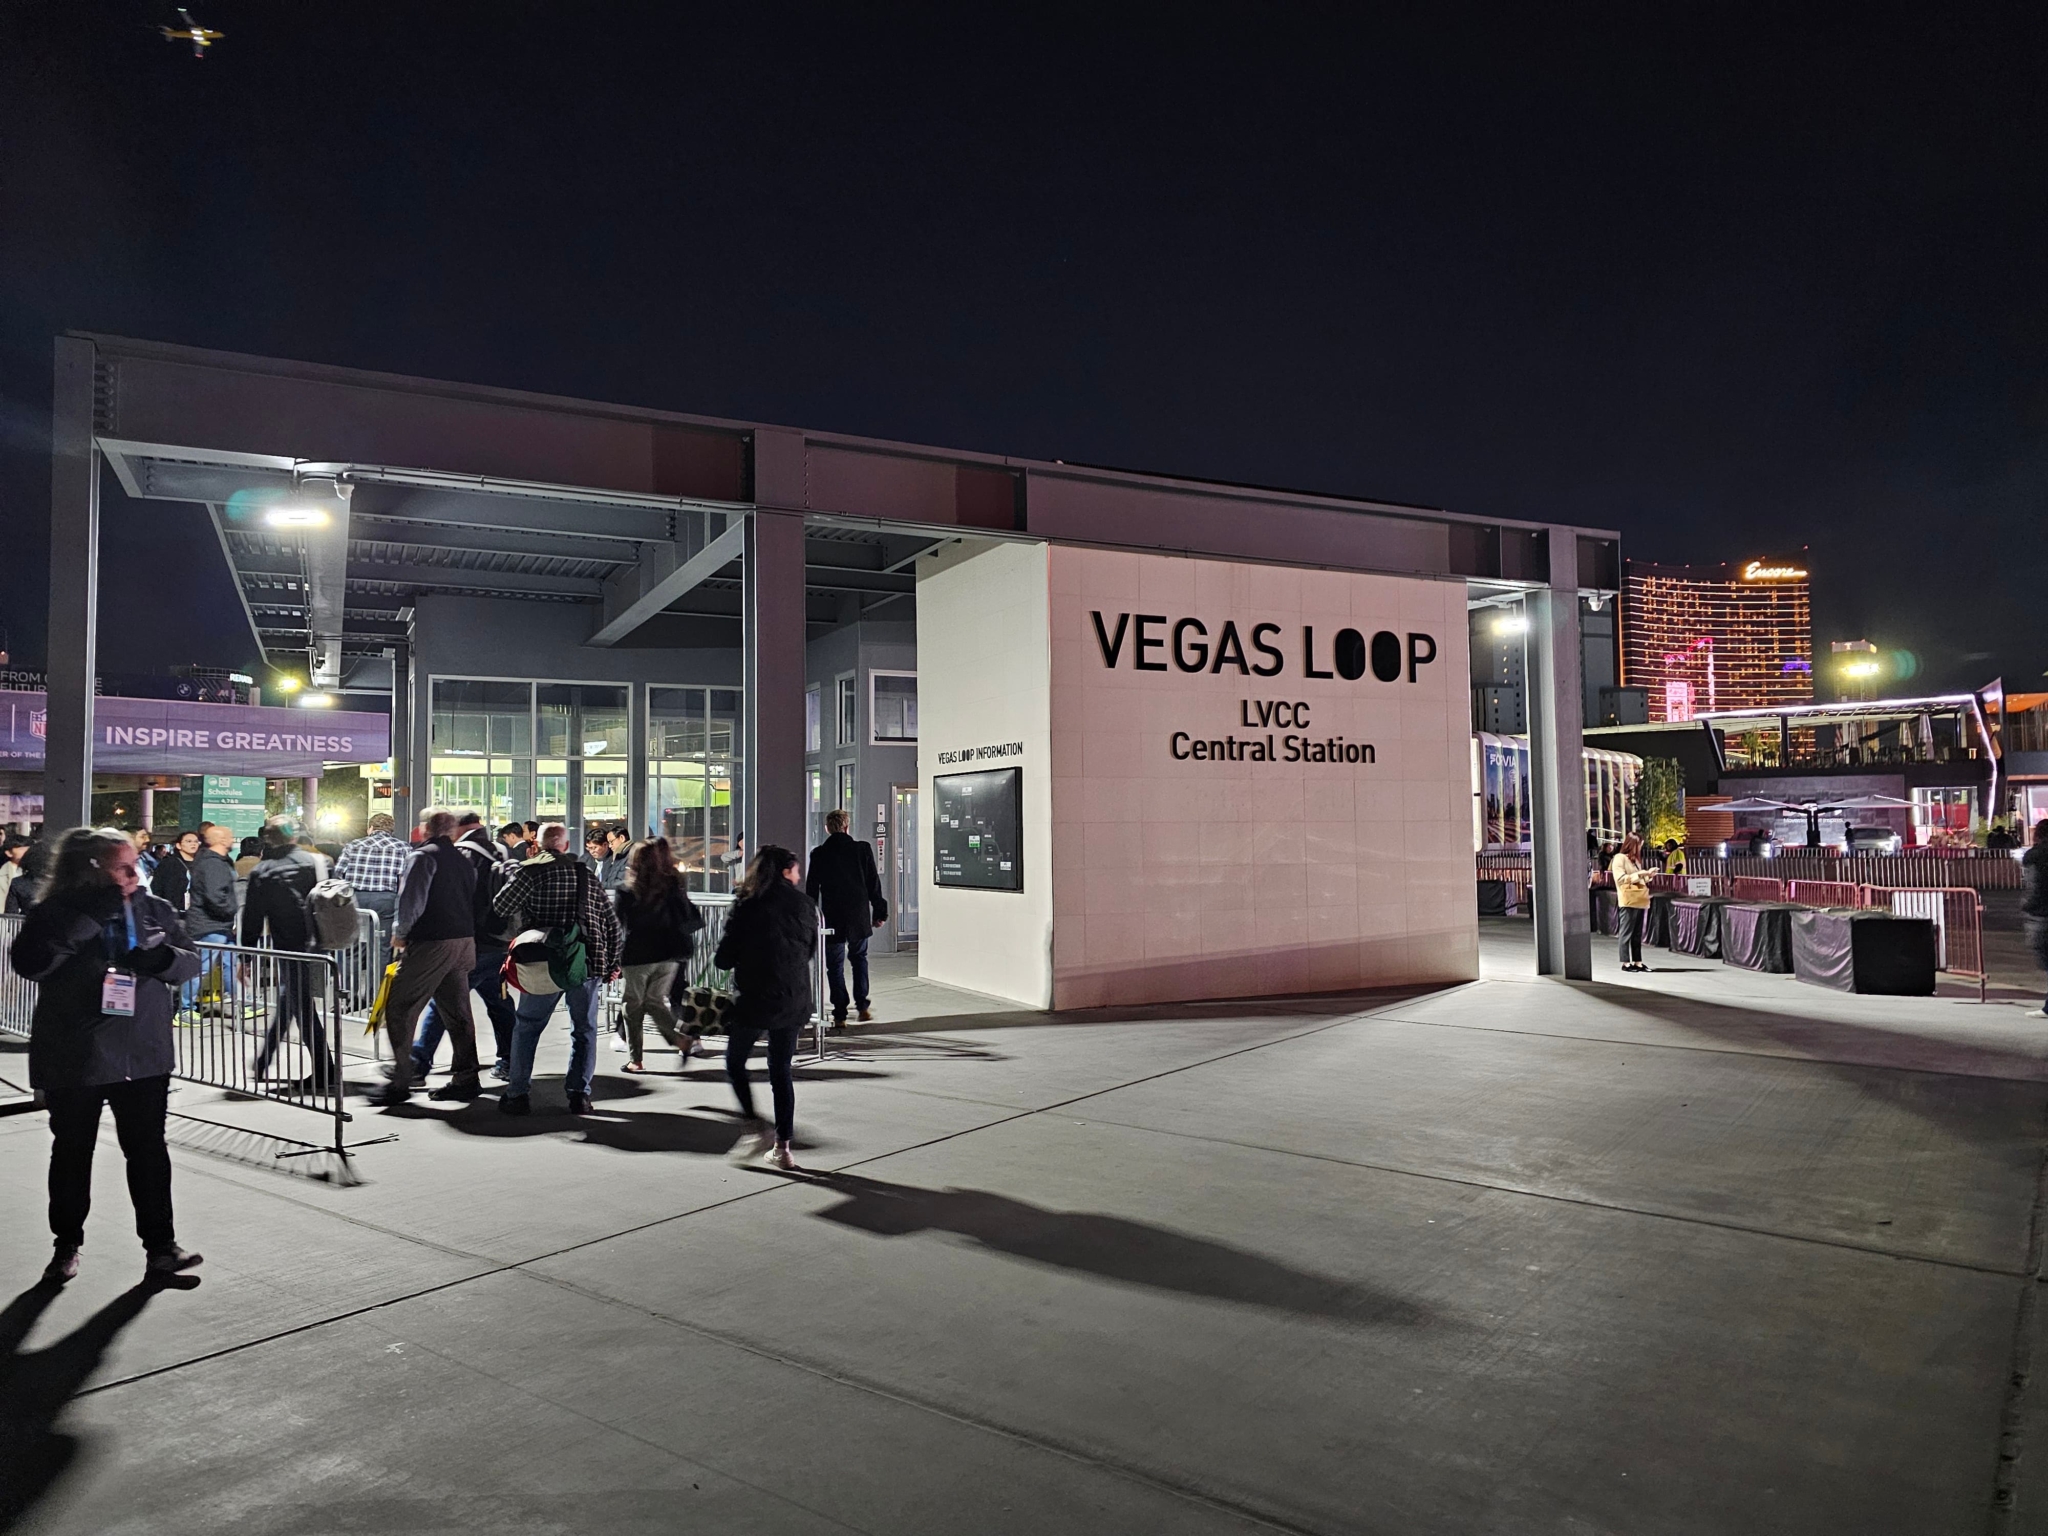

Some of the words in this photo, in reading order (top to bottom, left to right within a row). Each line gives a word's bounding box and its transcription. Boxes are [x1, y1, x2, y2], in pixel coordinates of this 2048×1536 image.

[1745, 561, 1807, 579] Encore
[1090, 611, 1284, 677] VEGAS
[1303, 626, 1437, 683] LOOP
[0, 671, 40, 683] FROM
[1241, 699, 1310, 728] LVCC
[106, 726, 209, 748] INSPIRE
[217, 731, 353, 752] GREATNESS
[1171, 732, 1276, 761] Central
[1283, 735, 1376, 763] Station
[938, 751, 957, 764] VEGAS
[958, 749, 974, 762] LOOP
[976, 742, 1023, 760] INFORMATION
